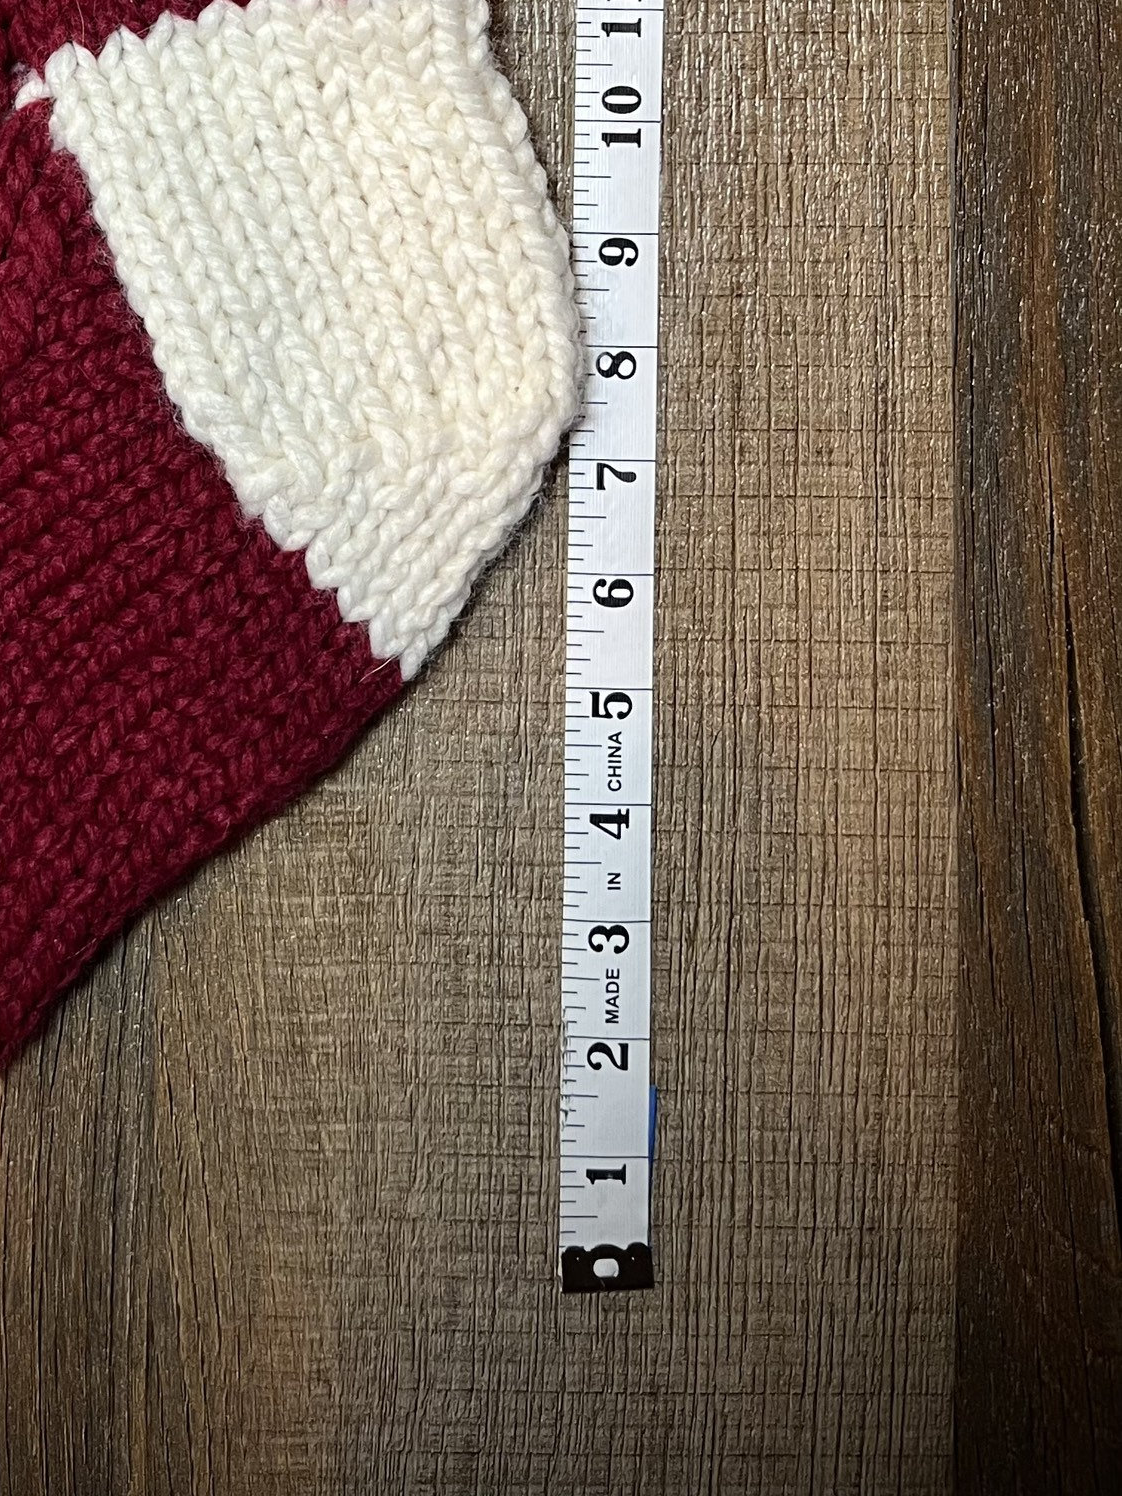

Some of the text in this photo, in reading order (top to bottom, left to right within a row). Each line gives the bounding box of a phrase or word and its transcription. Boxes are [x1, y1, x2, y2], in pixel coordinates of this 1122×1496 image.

[601, 85, 642, 148] 10
[598, 237, 639, 267] 9
[595, 351, 637, 380] 8
[596, 462, 637, 491] 7
[592, 578, 634, 608] 6
[589, 690, 633, 721] 5
[588, 807, 631, 841] 4
[605, 731, 622, 1024] MADE IN CHINA
[587, 923, 630, 955] 3
[586, 1041, 629, 1072] 2
[585, 1163, 627, 1186] 1
